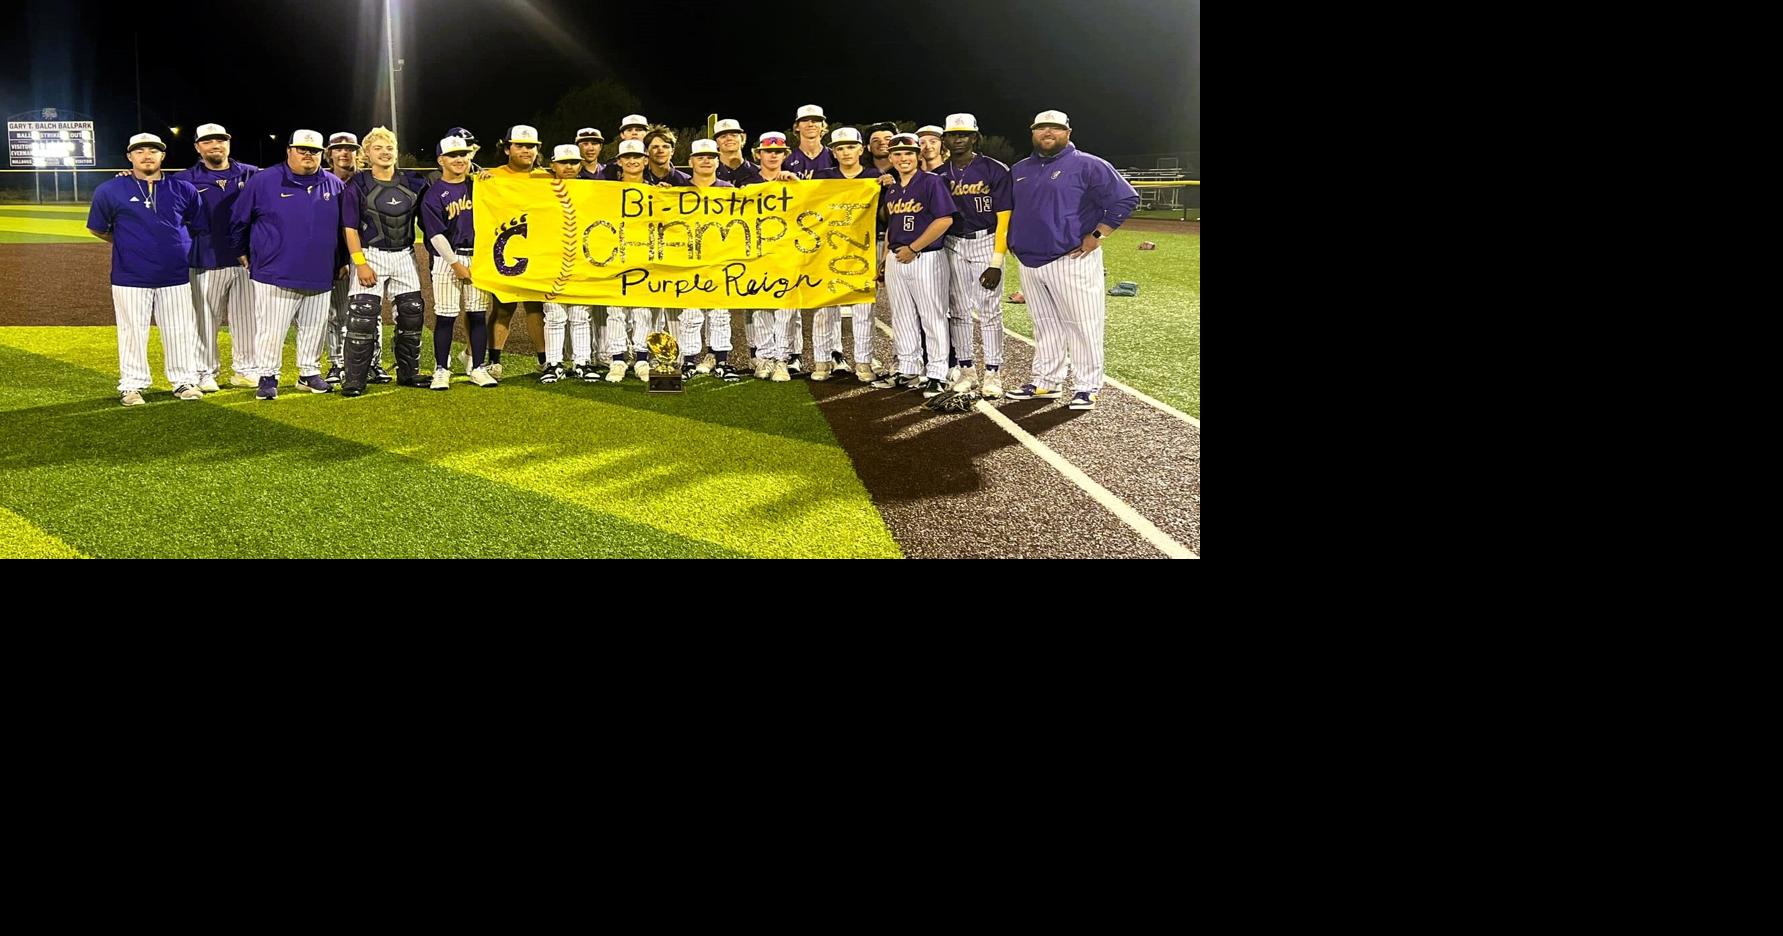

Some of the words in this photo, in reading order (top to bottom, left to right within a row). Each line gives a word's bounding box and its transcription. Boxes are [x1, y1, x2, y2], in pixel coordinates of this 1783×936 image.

[974, 196, 992, 212] 13
[582, 210, 824, 267] CHAMPS
[903, 216, 915, 231] 5
[826, 202, 870, 294] 2024
[615, 268, 718, 298] Purple
[722, 262, 823, 298] Reign
